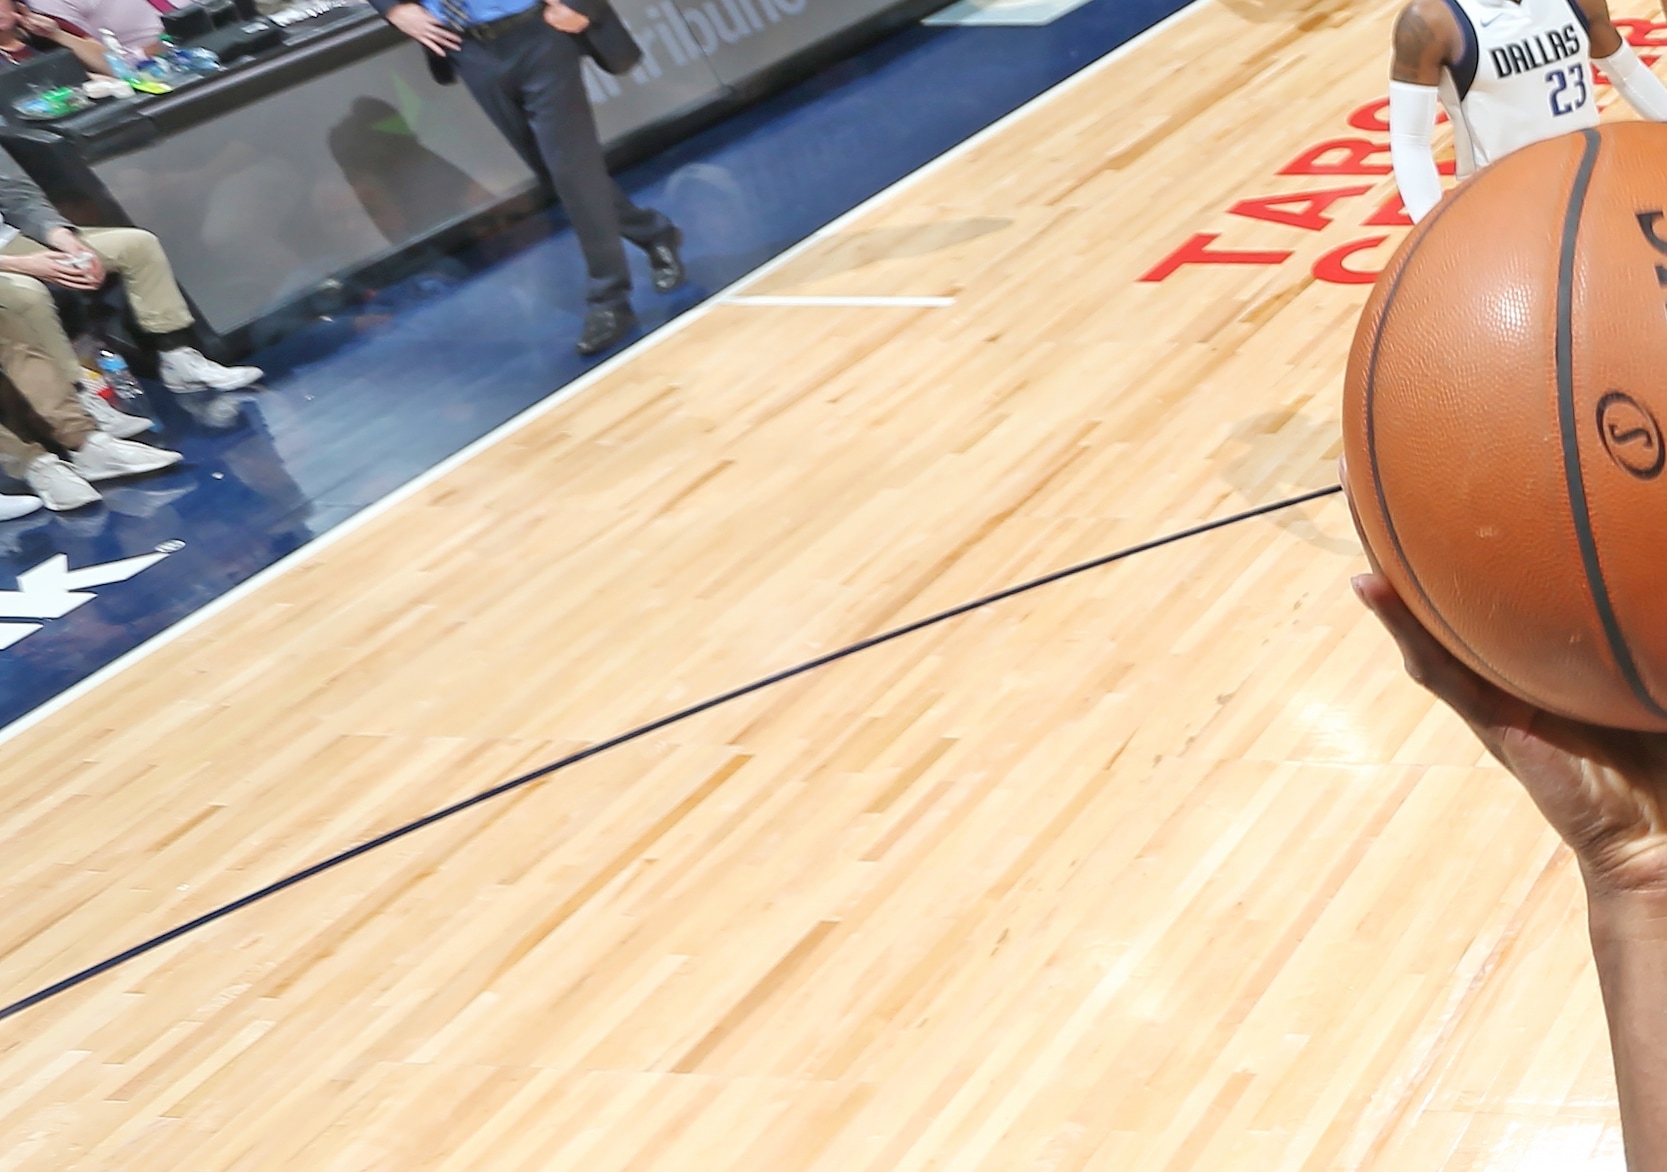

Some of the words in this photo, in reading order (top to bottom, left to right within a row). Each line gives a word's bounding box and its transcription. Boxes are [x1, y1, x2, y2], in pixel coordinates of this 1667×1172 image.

[628, 0, 808, 85] ribun
[1488, 22, 1580, 79] DALLAS
[1544, 62, 1587, 118] 23
